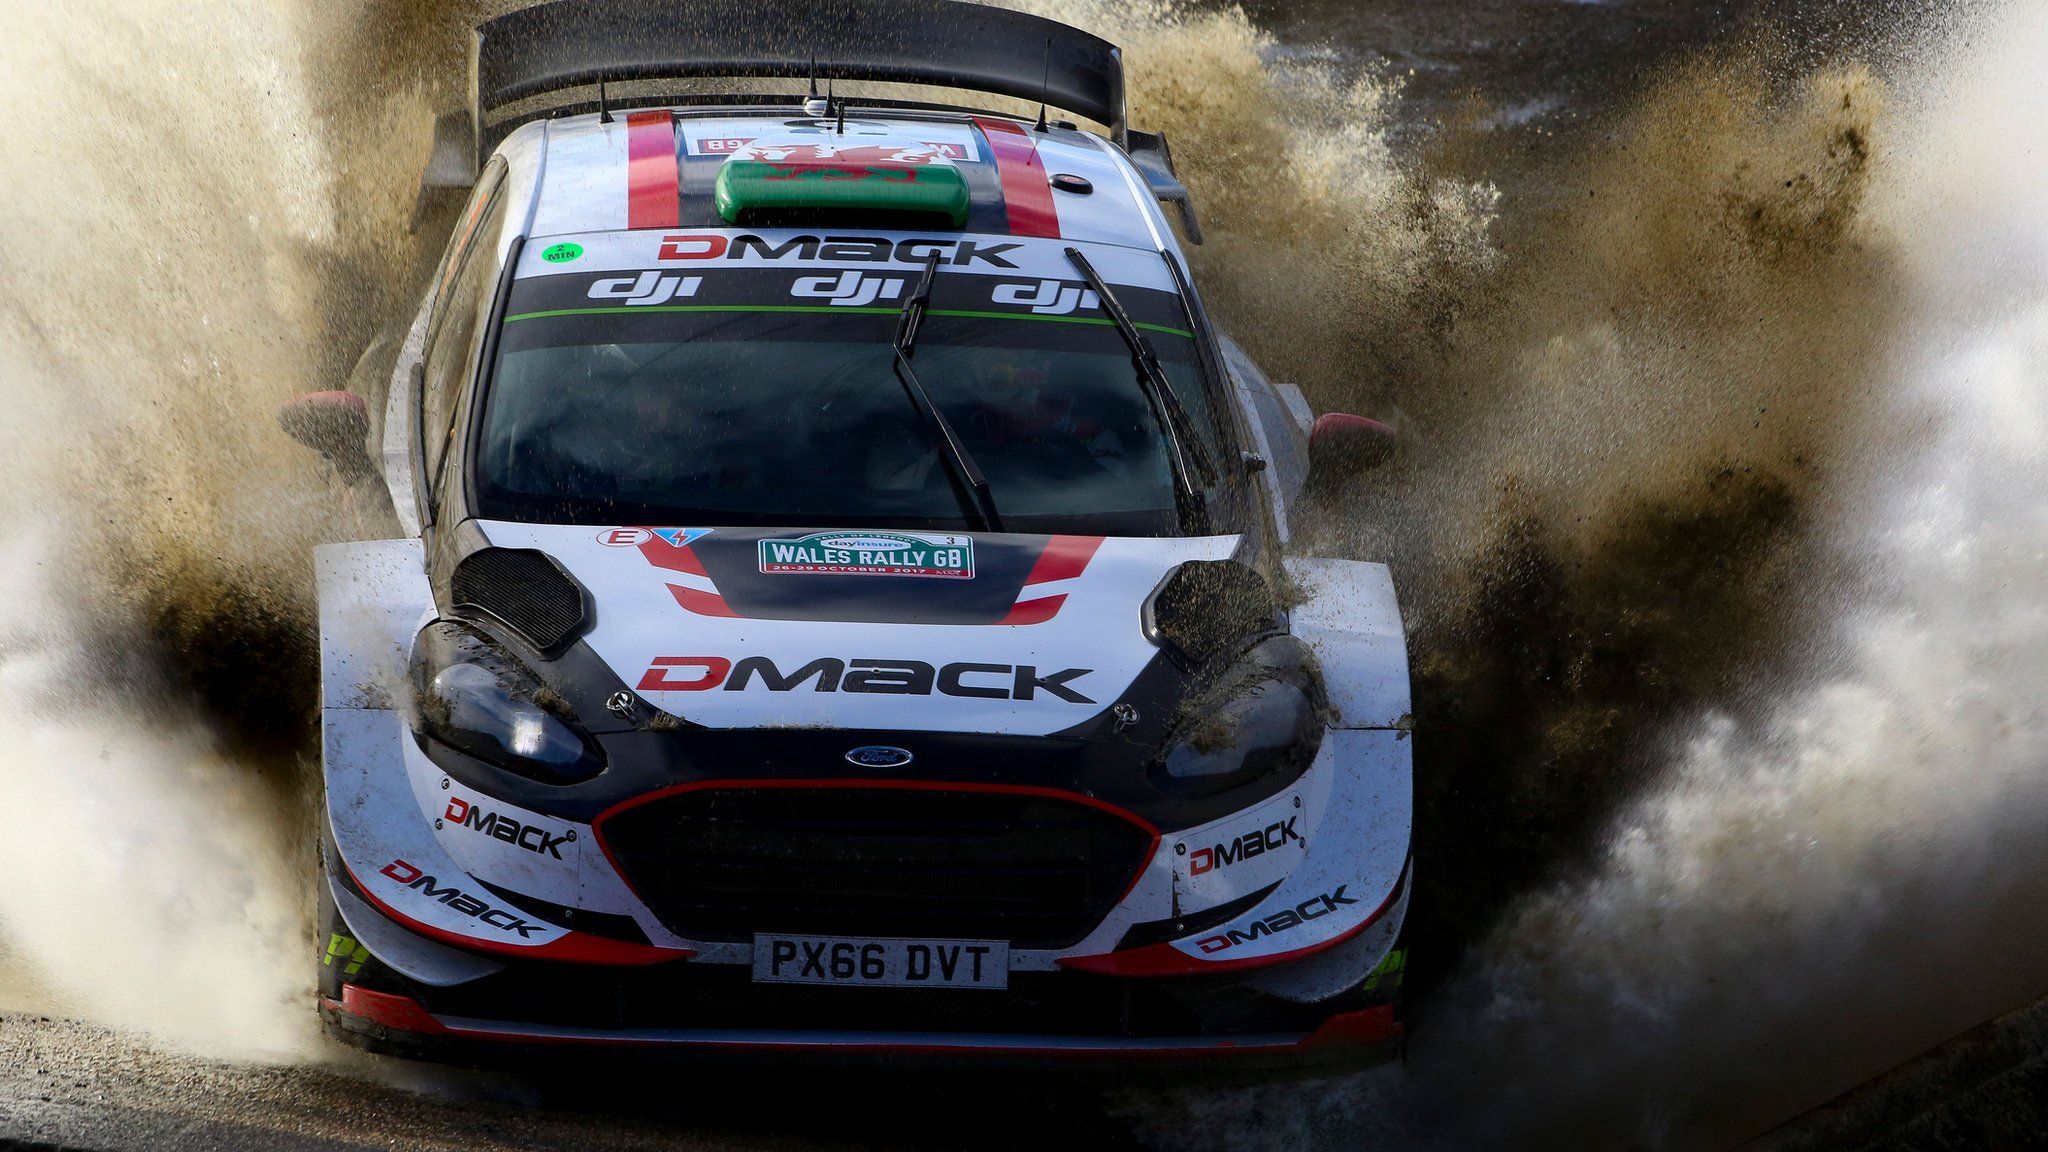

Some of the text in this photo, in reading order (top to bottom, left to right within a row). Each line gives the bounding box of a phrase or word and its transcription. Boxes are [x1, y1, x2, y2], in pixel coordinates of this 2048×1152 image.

[557, 244, 565, 252] 2
[547, 251, 575, 261] MIN
[608, 531, 639, 544] E
[946, 537, 955, 545] 3
[828, 540, 903, 548] dayinsure
[772, 543, 962, 568] WALES RALLY GB
[771, 940, 991, 982] PX66 DVT
